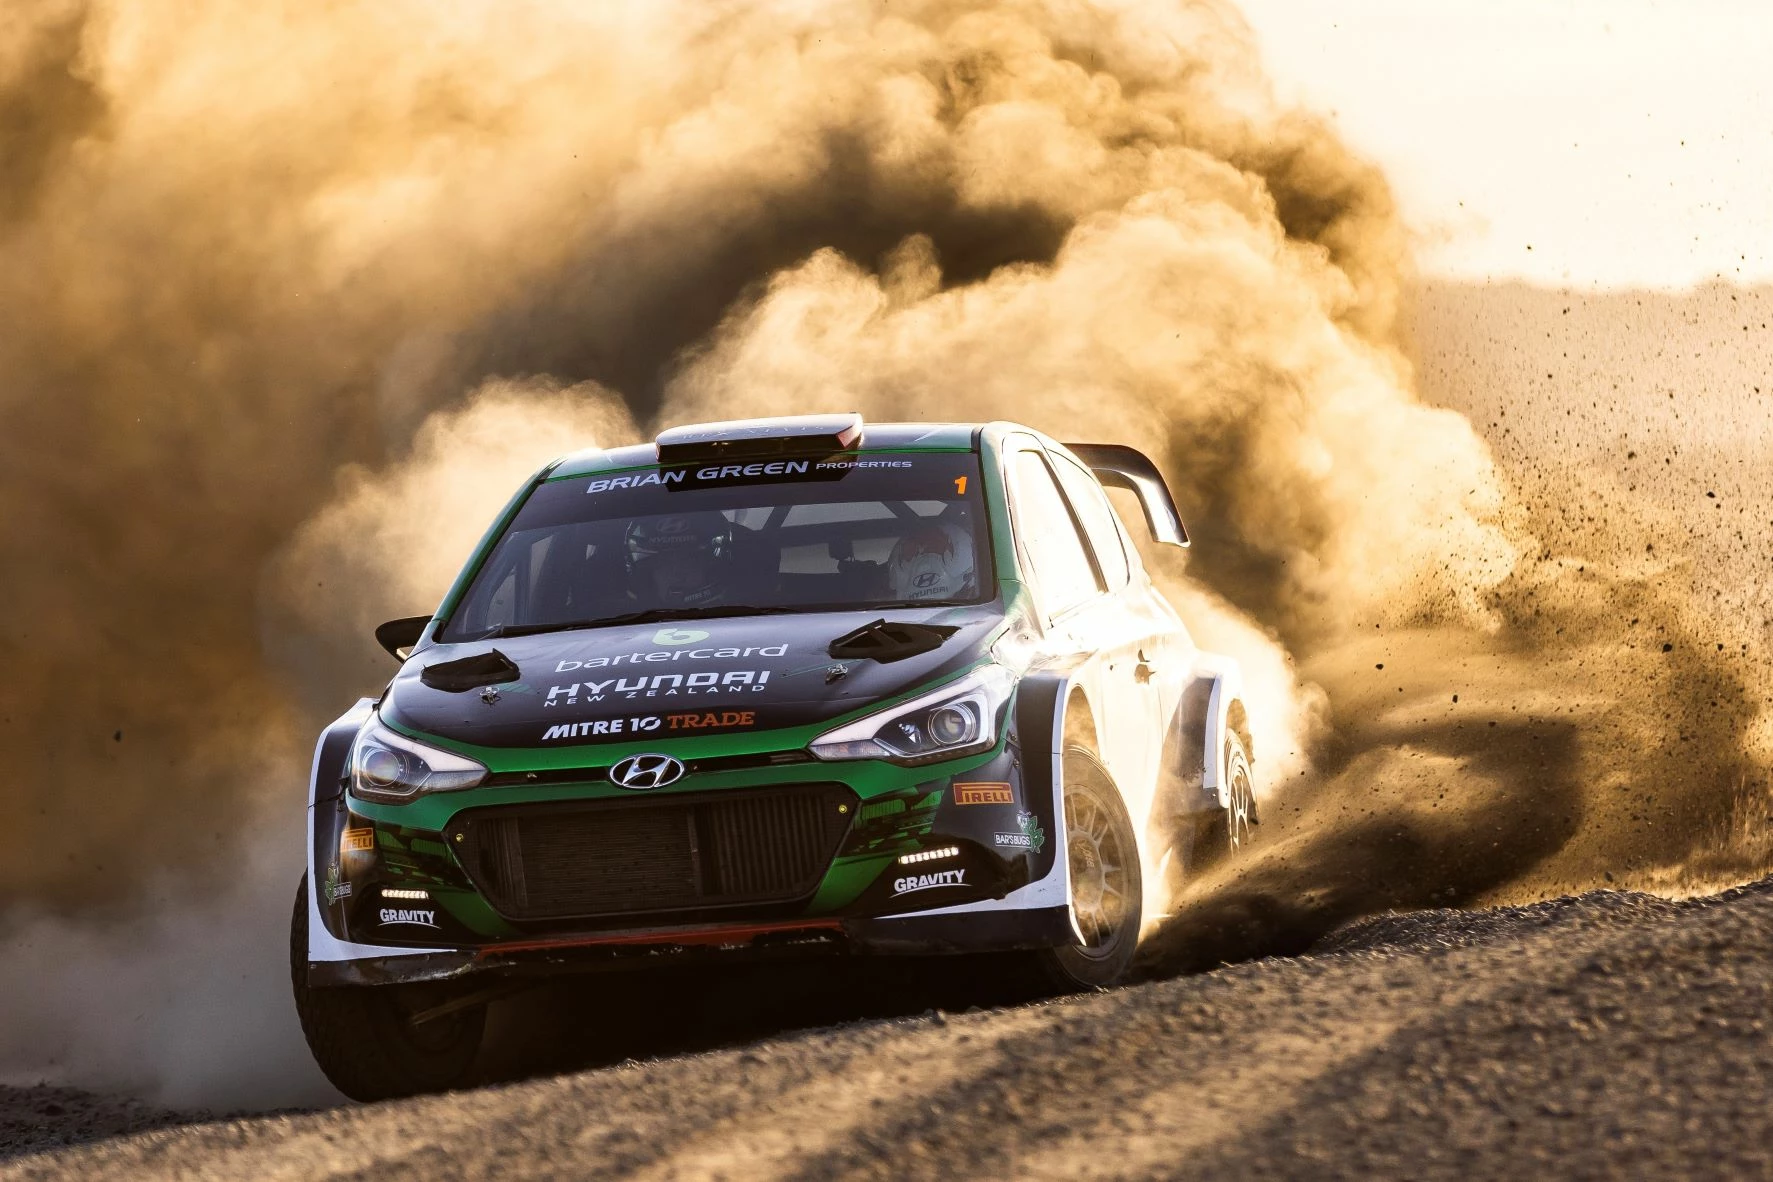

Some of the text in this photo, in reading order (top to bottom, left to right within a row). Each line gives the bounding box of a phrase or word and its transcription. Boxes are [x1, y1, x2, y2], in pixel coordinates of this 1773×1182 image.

[586, 460, 913, 494] BRIAN GREEN PROPERTIES
[953, 476, 968, 495] 1
[908, 586, 949, 600] HYUNDAI
[554, 643, 789, 673] bartercard
[544, 684, 766, 707] NEW ZEALAND
[546, 670, 771, 700] HYUNDAI
[541, 711, 756, 740] MITRE 10 TRADE
[955, 783, 1012, 803] PIRELLI
[341, 829, 373, 850] PELLI
[1014, 835, 1031, 846] BUGS
[894, 868, 965, 892] GRAVITY
[379, 908, 435, 925] GRAVITY
